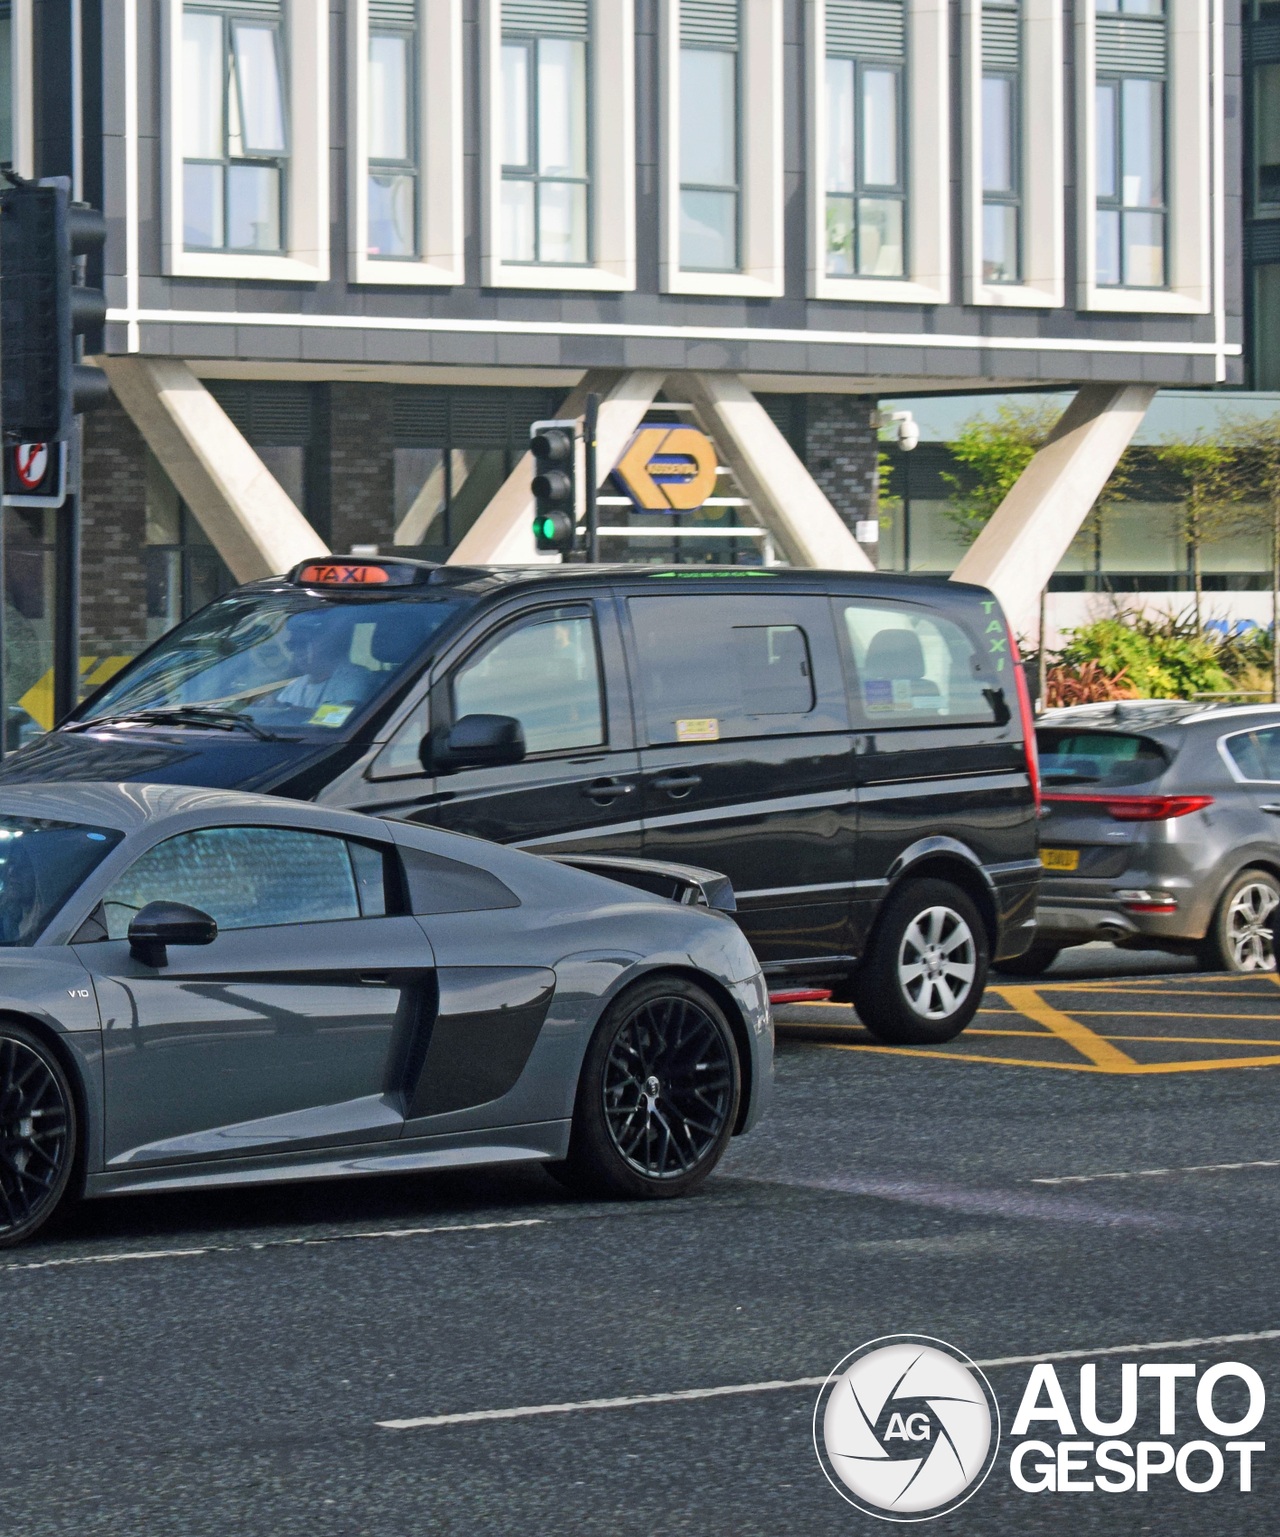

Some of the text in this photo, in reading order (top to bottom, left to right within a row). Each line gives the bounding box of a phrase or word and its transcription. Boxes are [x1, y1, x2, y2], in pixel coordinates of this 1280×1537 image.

[313, 567, 368, 583] TAXI
[980, 601, 1007, 672] TAXI
[67, 989, 89, 998] V10
